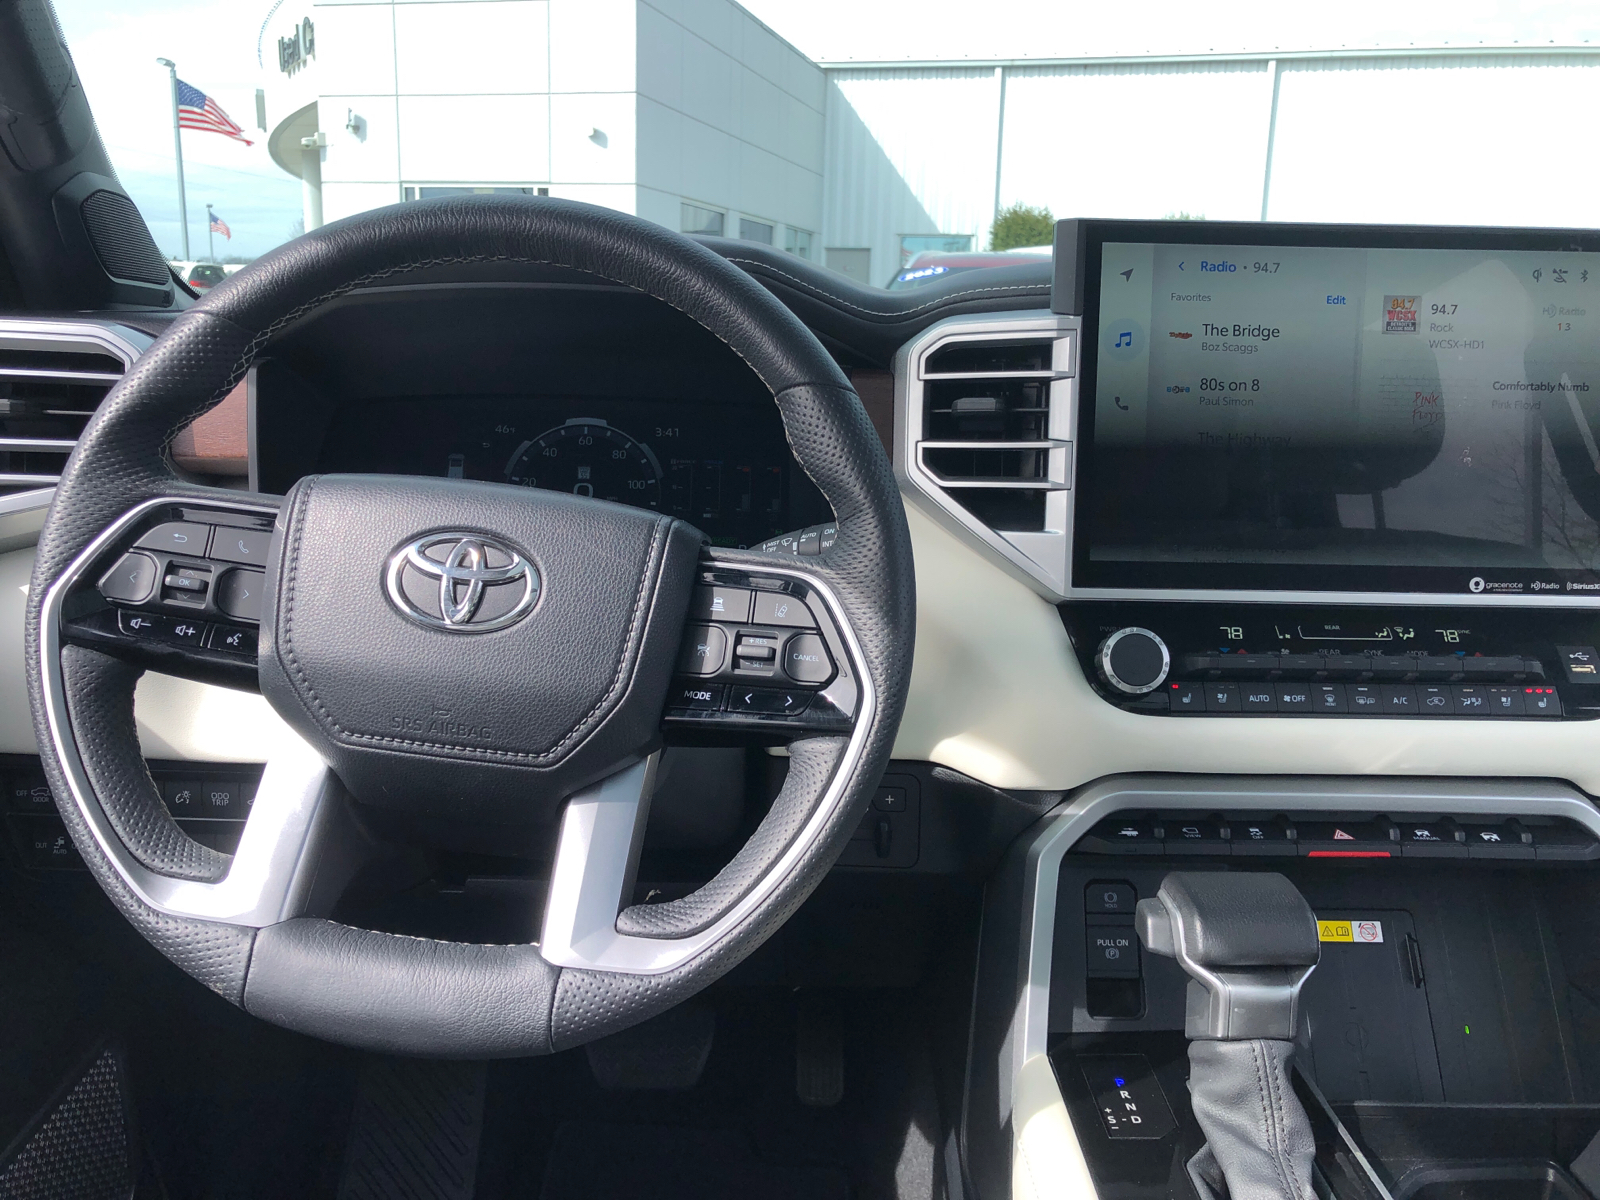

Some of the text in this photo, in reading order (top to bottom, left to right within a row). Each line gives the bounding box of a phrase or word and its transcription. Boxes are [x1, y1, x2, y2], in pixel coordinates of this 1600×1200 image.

[1200, 261, 1281, 274] Radio 94.7
[1170, 292, 1212, 303] Favorites
[1326, 295, 1347, 305] Edit
[1391, 298, 1415, 310] 94.7
[1430, 303, 1459, 315] 94.7
[1386, 310, 1417, 322] WCSX
[1202, 323, 1229, 337] The
[1232, 323, 1281, 341] Bridge
[1429, 322, 1454, 333] Rock
[1201, 342, 1259, 355] Boz Scaggs
[1429, 339, 1485, 350] WCSX-HD1
[1200, 378, 1225, 392] 80s
[1228, 381, 1247, 392] on
[1251, 379, 1260, 392] 8
[1492, 381, 1590, 393] Comfortably Numb
[1199, 396, 1254, 407] Paul Simon
[1492, 400, 1541, 411] Pink Floyd
[655, 427, 679, 437] 3:41
[578, 436, 593, 446] 60
[1198, 431, 1292, 447] The Highway
[542, 447, 558, 457] 40
[612, 449, 627, 460] 80
[522, 477, 537, 487] 20
[627, 480, 646, 490] 100
[822, 540, 833, 548] INT
[178, 579, 190, 587] OK
[1485, 581, 1524, 590] gracenote
[1541, 582, 1560, 590] Radio
[1219, 626, 1243, 640] 78
[1435, 629, 1459, 643] 78
[793, 653, 819, 662] CANCEL
[684, 690, 712, 700] MODE
[1249, 694, 1270, 703] AUTO
[1291, 695, 1306, 703] OFF
[1393, 696, 1408, 705] A/C
[391, 716, 492, 740] SRS AIRBAG
[16, 789, 28, 797] OFF
[211, 792, 230, 800] ODO
[1097, 938, 1129, 947] PULL ON
[1114, 1077, 1125, 1087] P
[1119, 1090, 1131, 1099] R
[1125, 1102, 1137, 1111] N
[1107, 1115, 1117, 1124] S
[1130, 1115, 1142, 1124] D
